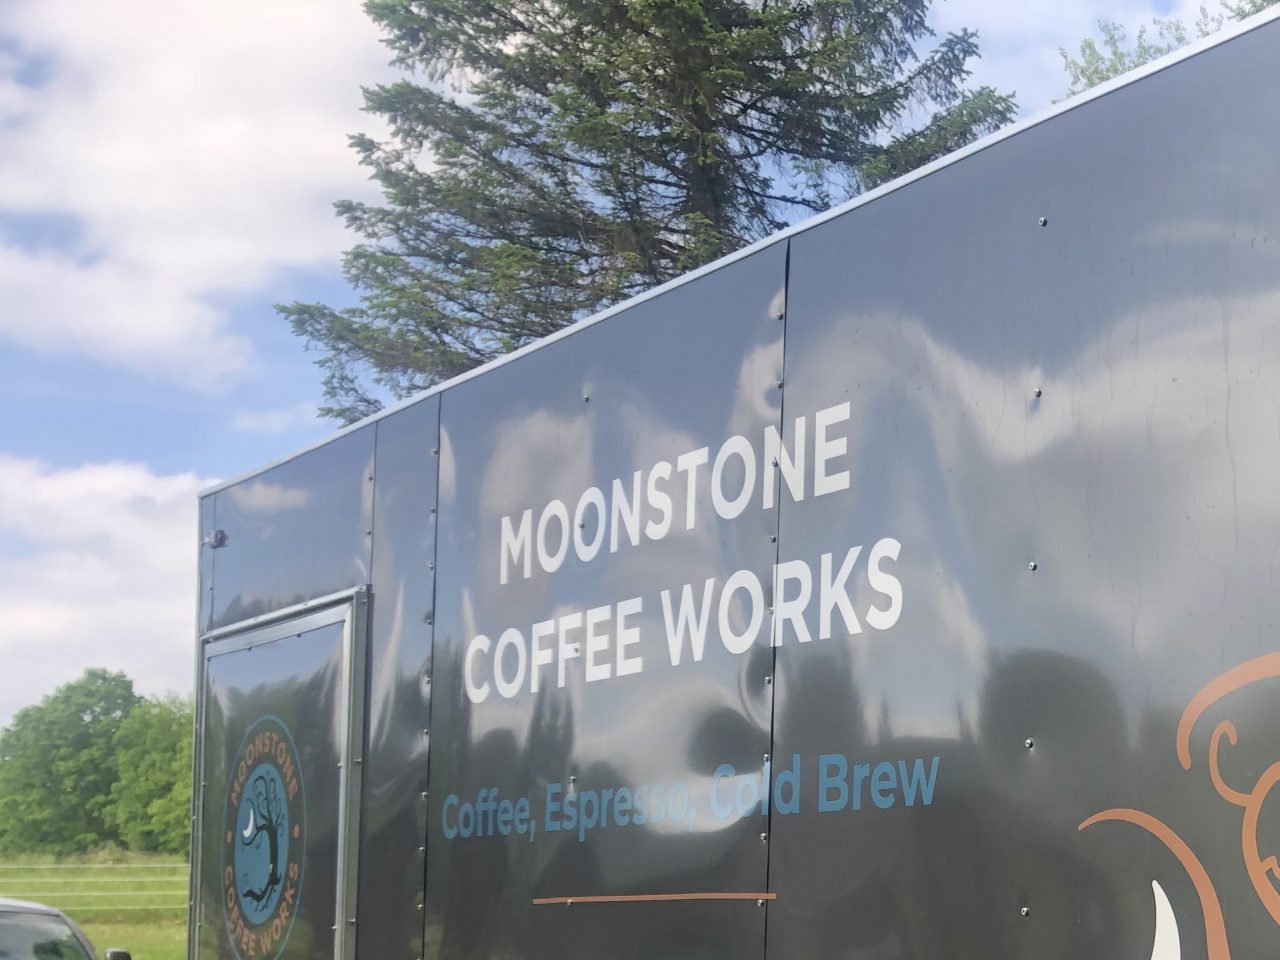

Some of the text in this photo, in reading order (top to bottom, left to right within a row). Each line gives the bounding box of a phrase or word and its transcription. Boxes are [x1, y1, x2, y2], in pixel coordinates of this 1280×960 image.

[499, 401, 851, 585] MOONSTONE
[464, 537, 904, 703] COFFEE WORKS
[231, 732, 299, 806] MOONSTONE
[442, 752, 941, 843] Coffee, Espresso, Cold Brew
[225, 862, 300, 957] COFFEE WORKS
